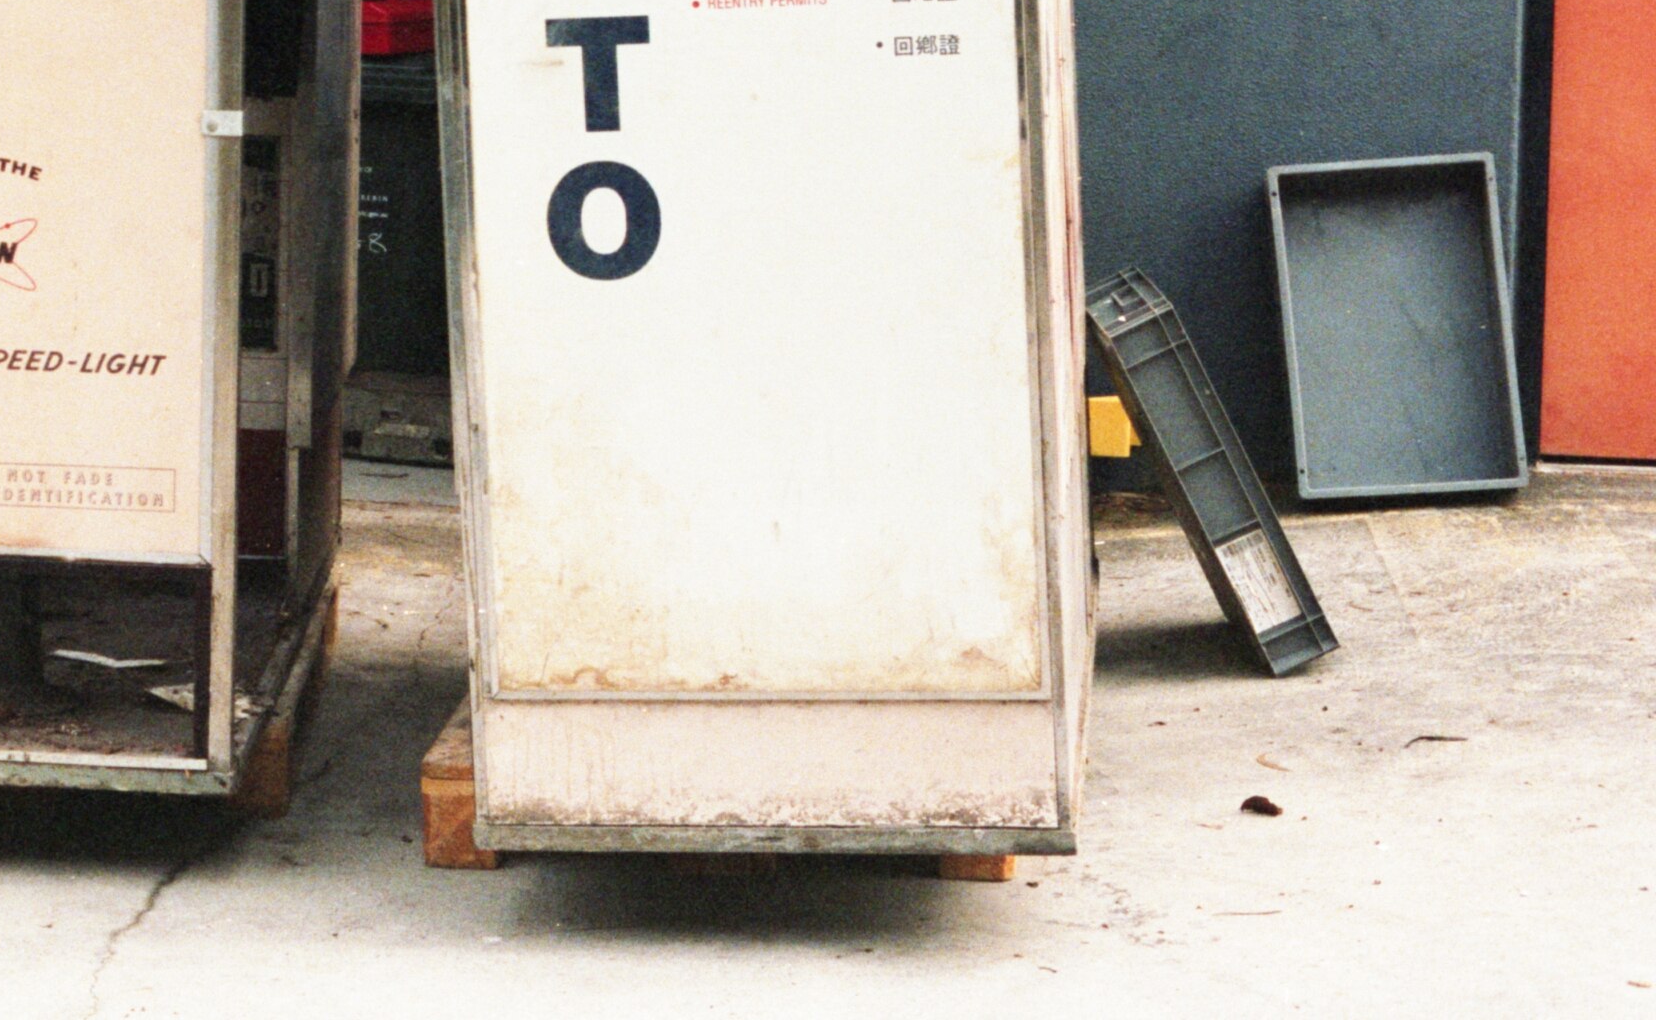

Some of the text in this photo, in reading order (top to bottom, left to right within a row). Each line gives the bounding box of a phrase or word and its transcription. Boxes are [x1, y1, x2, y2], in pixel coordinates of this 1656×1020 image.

[894, 34, 960, 56] 回鄉證
[6, 469, 47, 485] NOT
[63, 471, 115, 487] FADE
